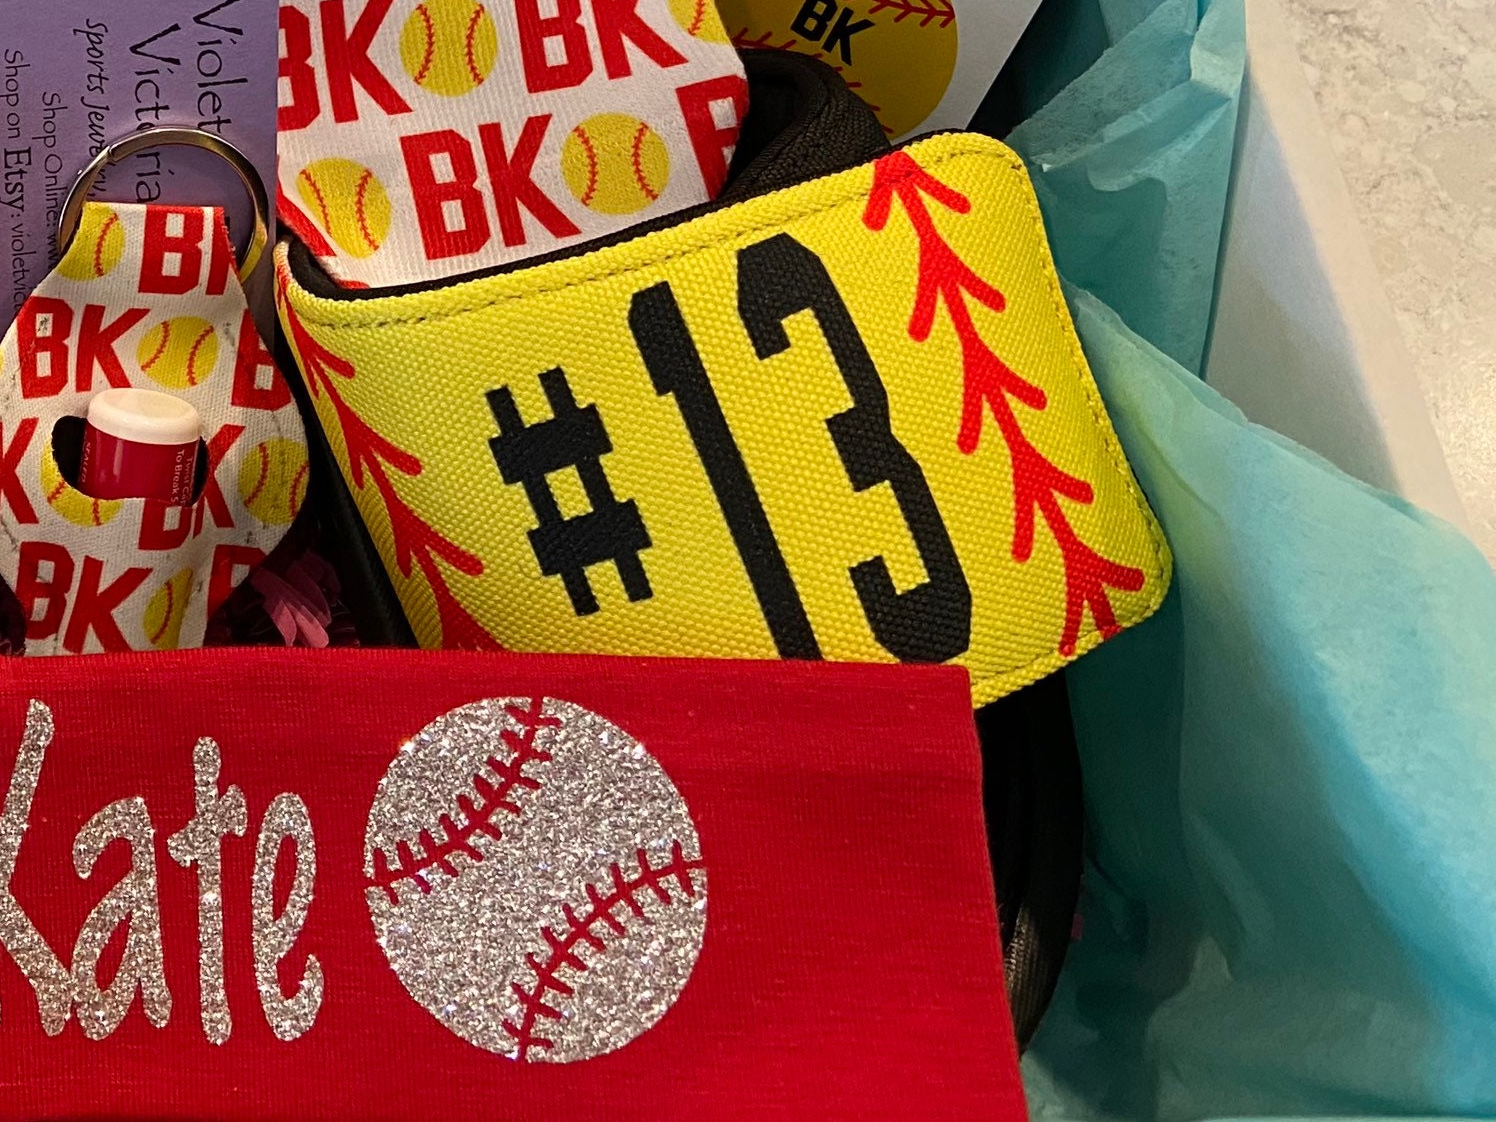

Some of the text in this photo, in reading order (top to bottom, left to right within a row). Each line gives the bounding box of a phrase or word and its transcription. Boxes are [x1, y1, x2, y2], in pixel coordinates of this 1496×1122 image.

[5, 112, 23, 140] on
[32, 91, 68, 148] Shop
[43, 154, 69, 228] Online:
[400, 114, 582, 262] BK
[9, 223, 37, 315] violetvict
[17, 296, 151, 399] BK
[171, 466, 183, 495] Break
[175, 449, 185, 462] To
[485, 232, 973, 666] #13
[15, 541, 153, 653] BK
